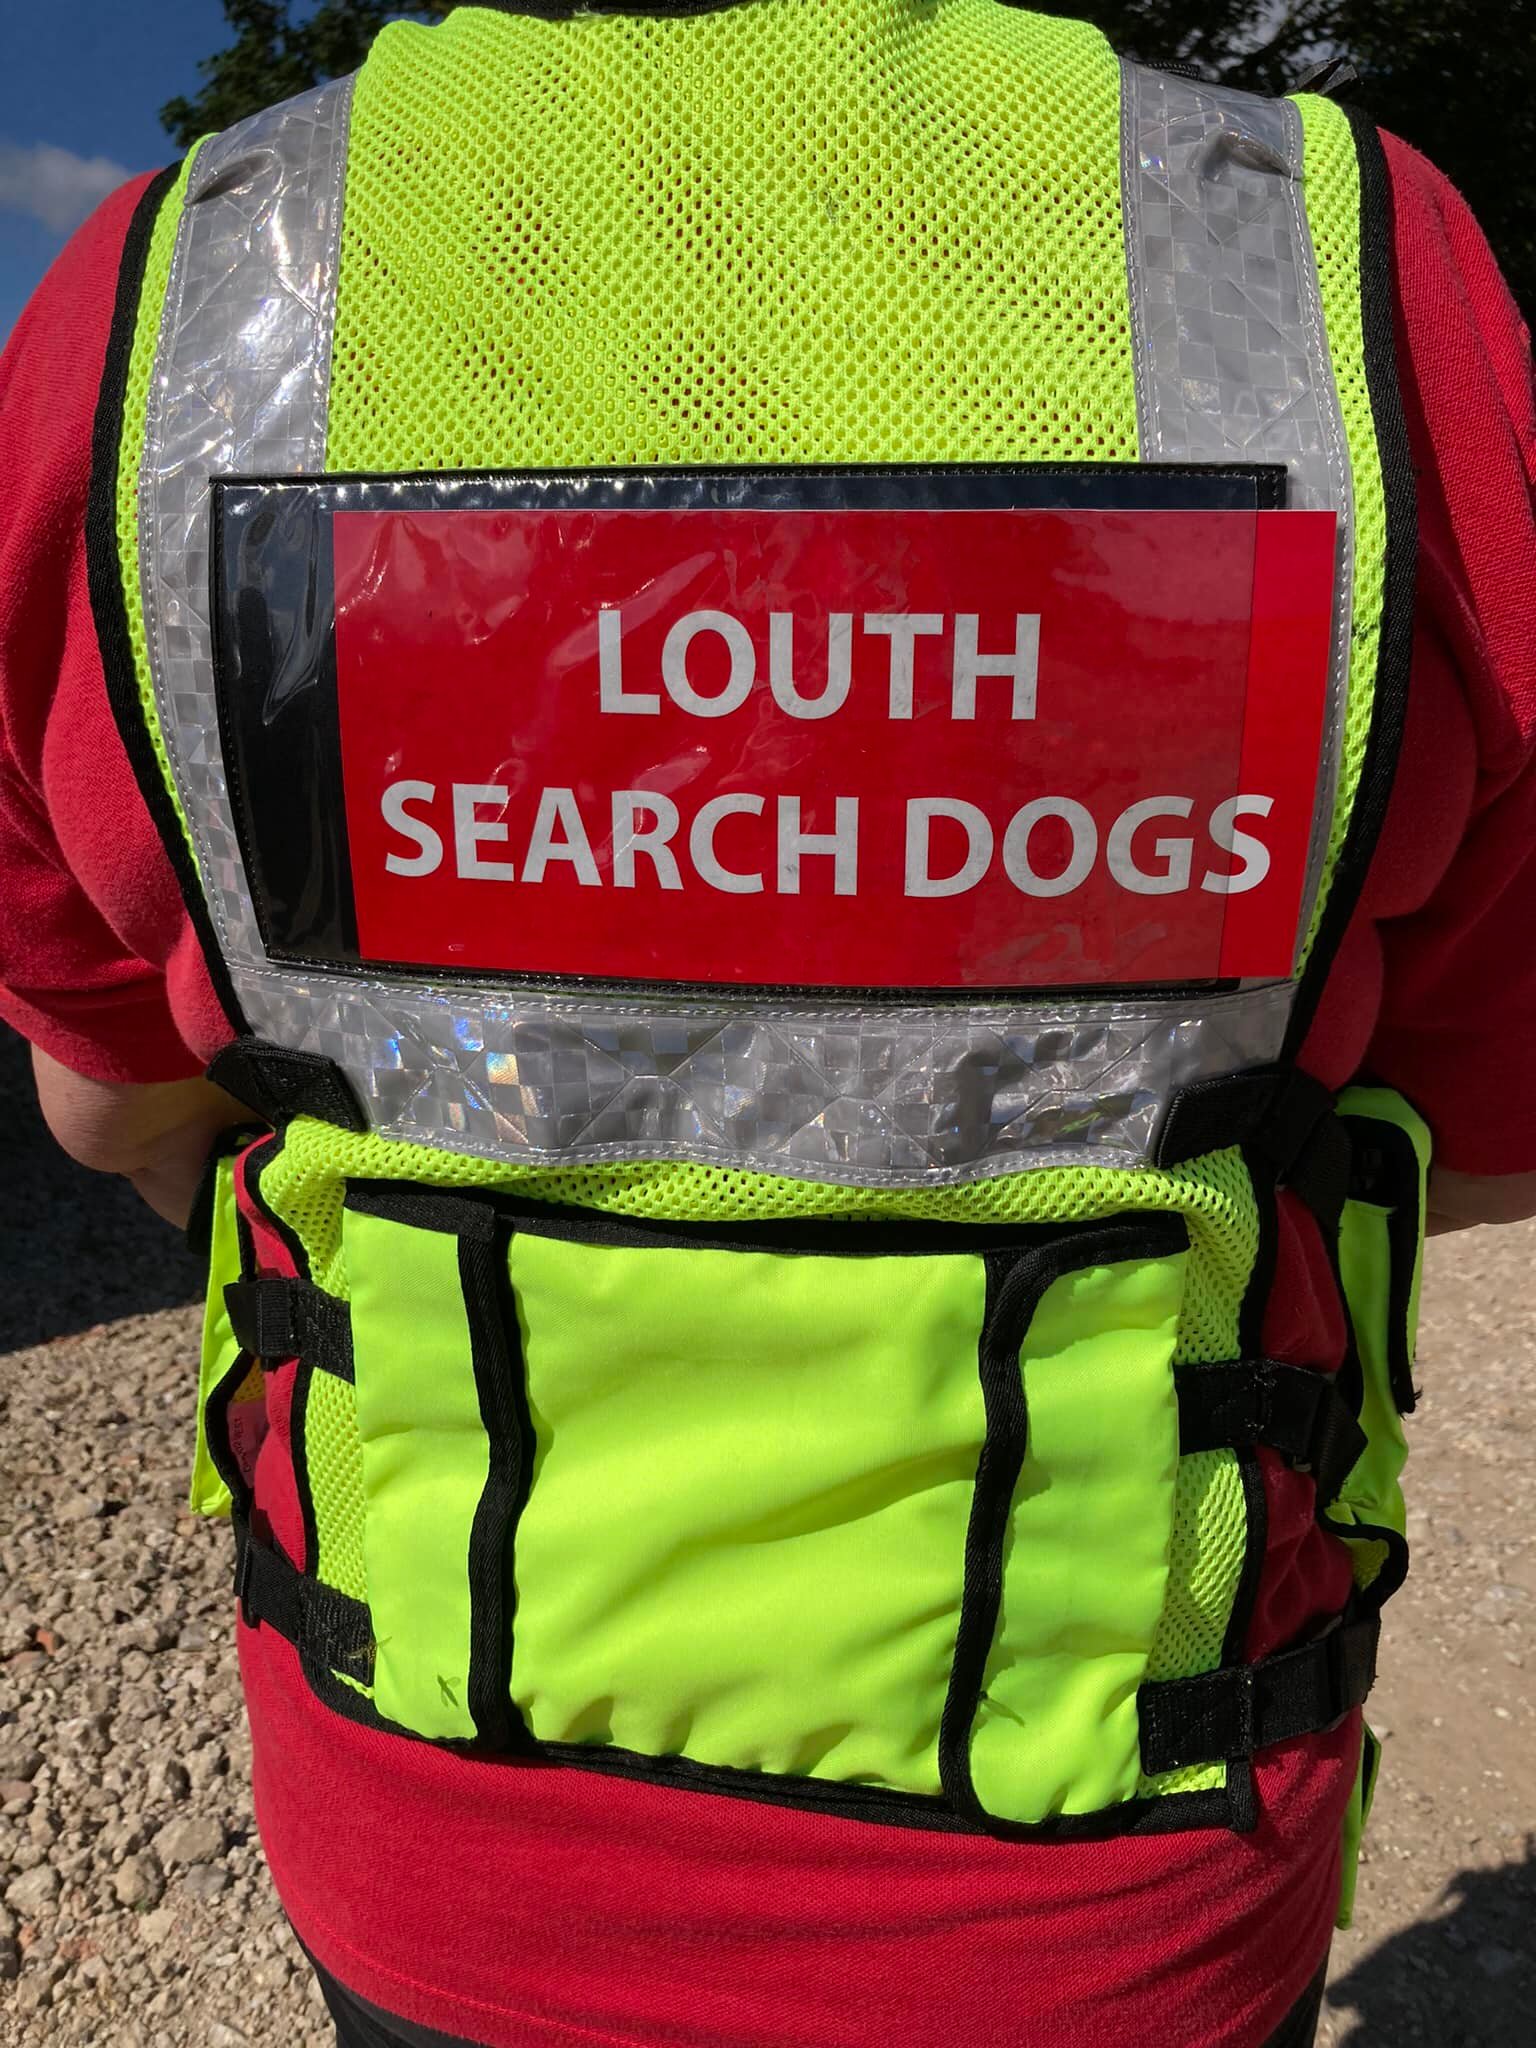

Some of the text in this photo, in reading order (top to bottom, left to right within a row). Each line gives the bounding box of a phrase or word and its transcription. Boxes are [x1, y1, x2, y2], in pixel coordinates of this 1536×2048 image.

[597, 608, 1041, 720] LOUTH
[381, 779, 1274, 899] SEARCH DOGS
